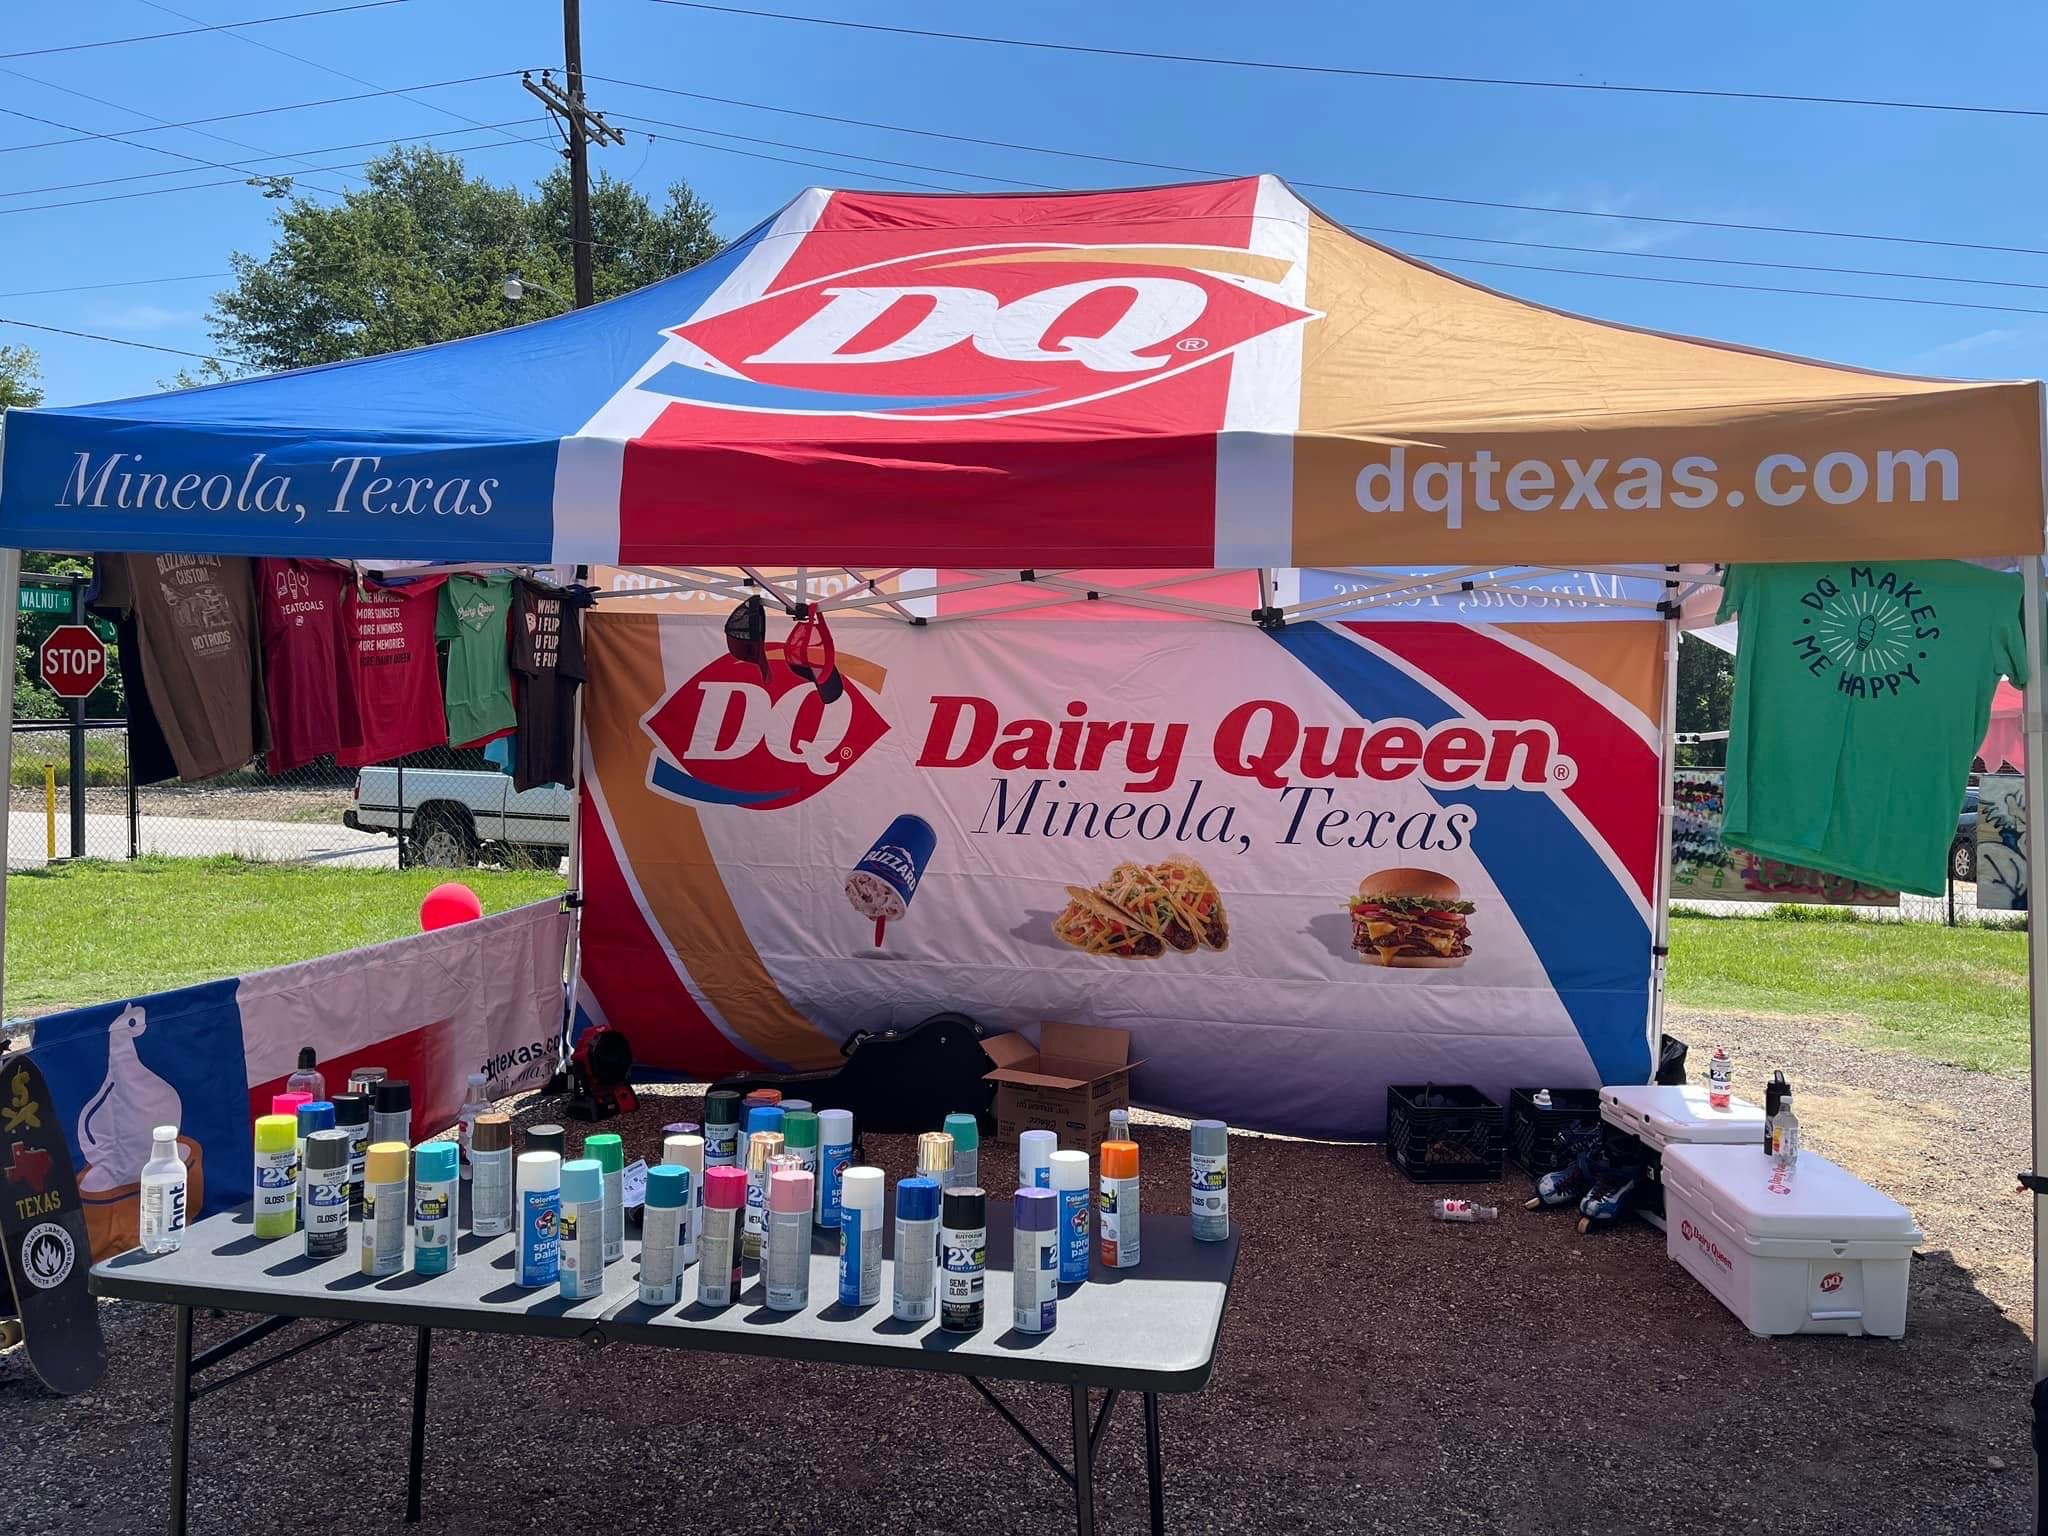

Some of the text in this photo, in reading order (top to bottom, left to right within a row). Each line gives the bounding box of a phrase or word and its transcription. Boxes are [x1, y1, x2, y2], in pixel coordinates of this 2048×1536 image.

[742, 277, 1209, 372] DQ
[55, 451, 500, 523] Mineola, Texas
[1355, 446, 1960, 529] dqtexas.com
[175, 567, 210, 585] CUSTOM
[21, 591, 59, 609] WALNUT
[537, 599, 561, 614] WHEN
[1800, 566, 1940, 640] DQ MAKES
[375, 607, 400, 619] SUNSETS
[376, 622, 403, 635] KINDNESS
[543, 617, 560, 632] FLIP
[191, 630, 231, 651] HOTRODS
[376, 637, 405, 651] MEMORIES
[543, 634, 559, 649] FLIP
[45, 648, 101, 675] STOP
[542, 653, 558, 668] FLIP
[1792, 634, 1921, 699] ME HAPPY
[684, 680, 852, 776] DQ
[916, 695, 1188, 793] Dairy
[970, 778, 1473, 851] Mineola, Texas
[1713, 1071, 1726, 1079] 2X
[705, 1138, 721, 1152] 2X
[264, 1167, 289, 1183] 2X
[265, 1194, 285, 1205] GLOSS
[315, 1184, 342, 1201] 2X
[16, 1189, 62, 1220] TEXAS
[168, 1182, 185, 1232] hint
[317, 1213, 338, 1223] GLOSS
[948, 1247, 975, 1266] 2X
[949, 1279, 969, 1288] SEMI-
[949, 1288, 969, 1297] GLOSS
